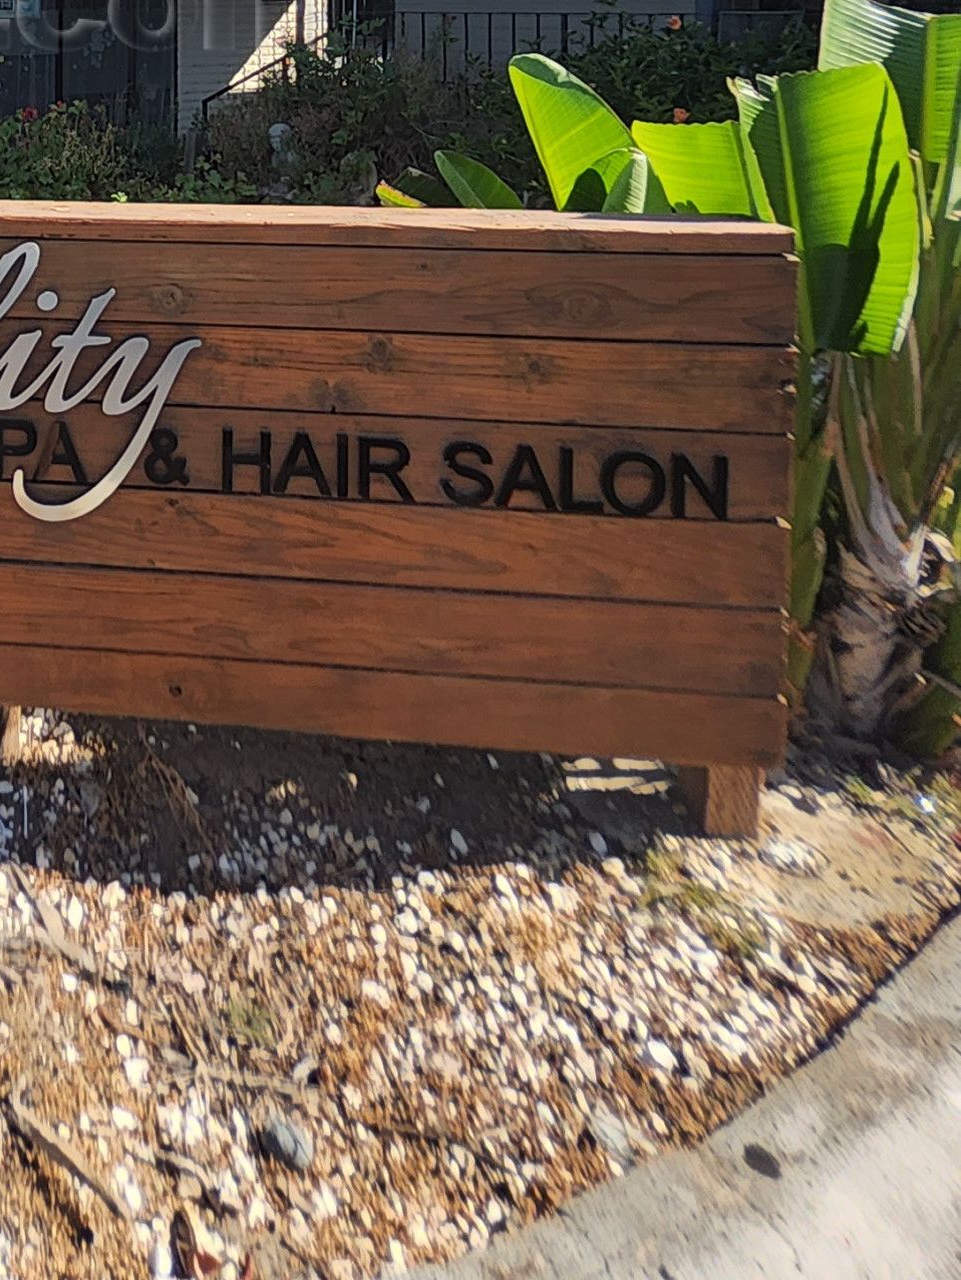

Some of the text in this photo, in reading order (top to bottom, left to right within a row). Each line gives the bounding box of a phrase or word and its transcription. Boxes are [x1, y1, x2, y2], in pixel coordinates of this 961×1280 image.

[142, 427, 191, 485] &
[222, 428, 415, 503] HAIR
[443, 440, 729, 518] SALON
